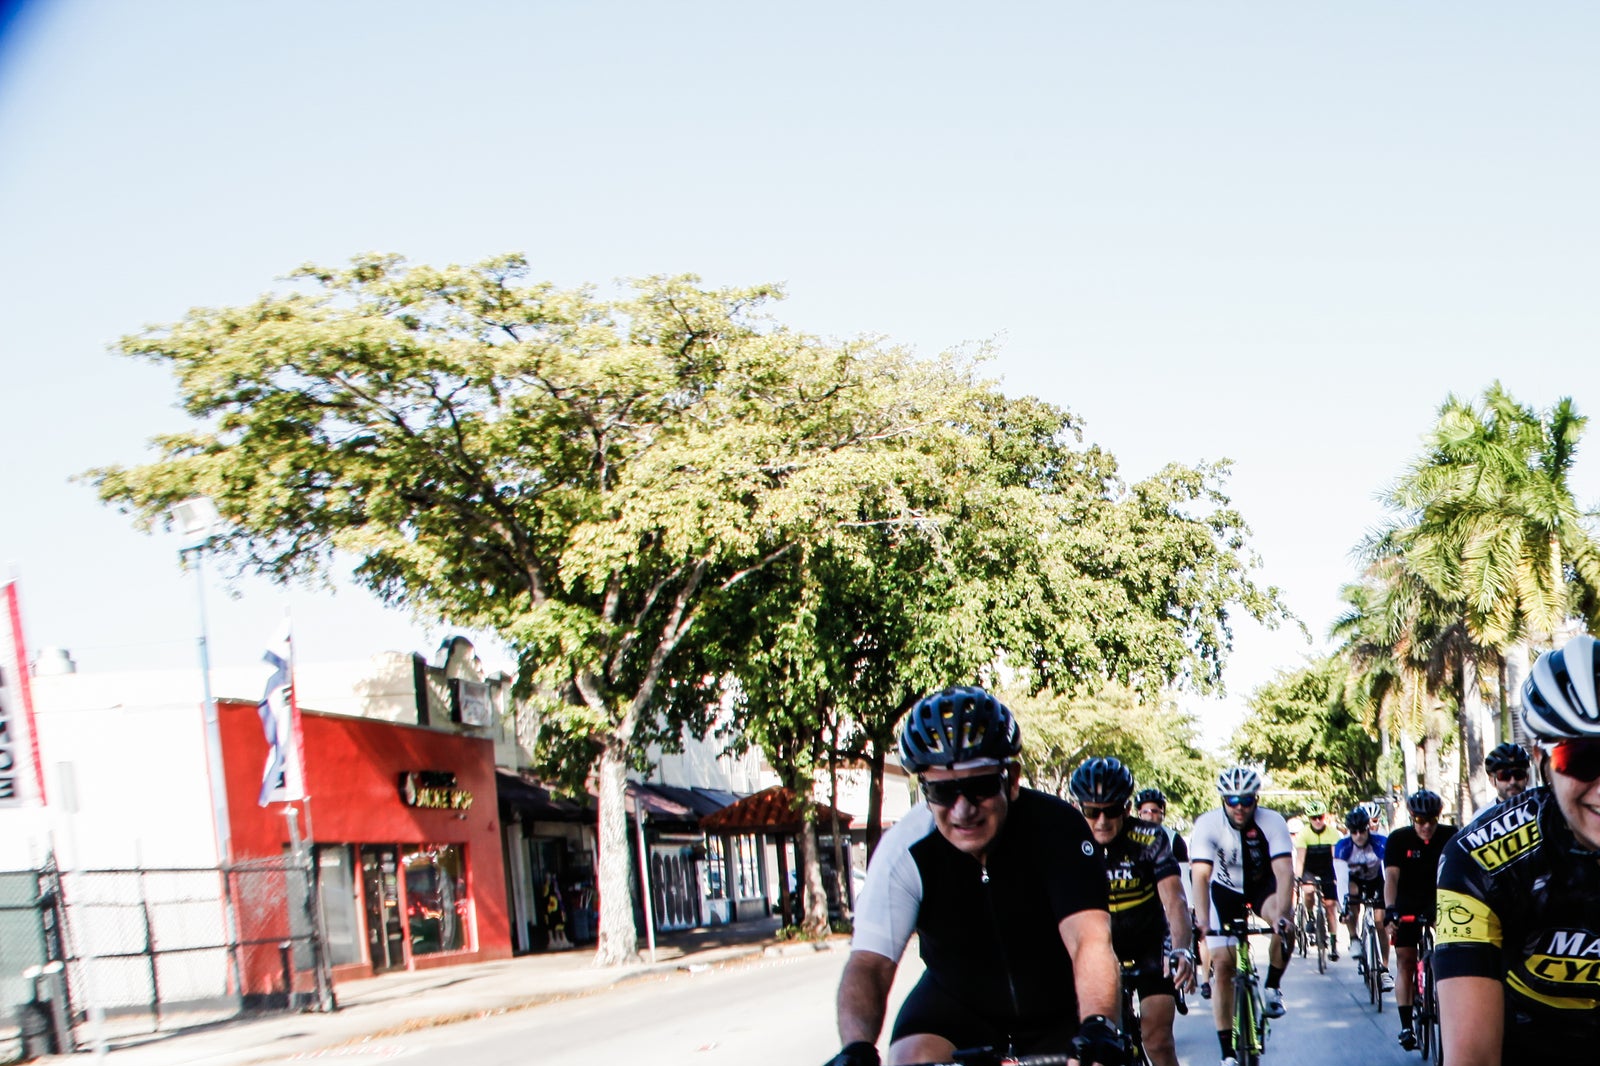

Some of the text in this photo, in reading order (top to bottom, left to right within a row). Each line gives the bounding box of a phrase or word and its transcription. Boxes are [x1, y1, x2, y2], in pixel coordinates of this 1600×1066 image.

[1466, 804, 1536, 849] MACK
[1478, 823, 1540, 869] CYCLE
[1106, 869, 1133, 880] ACK
